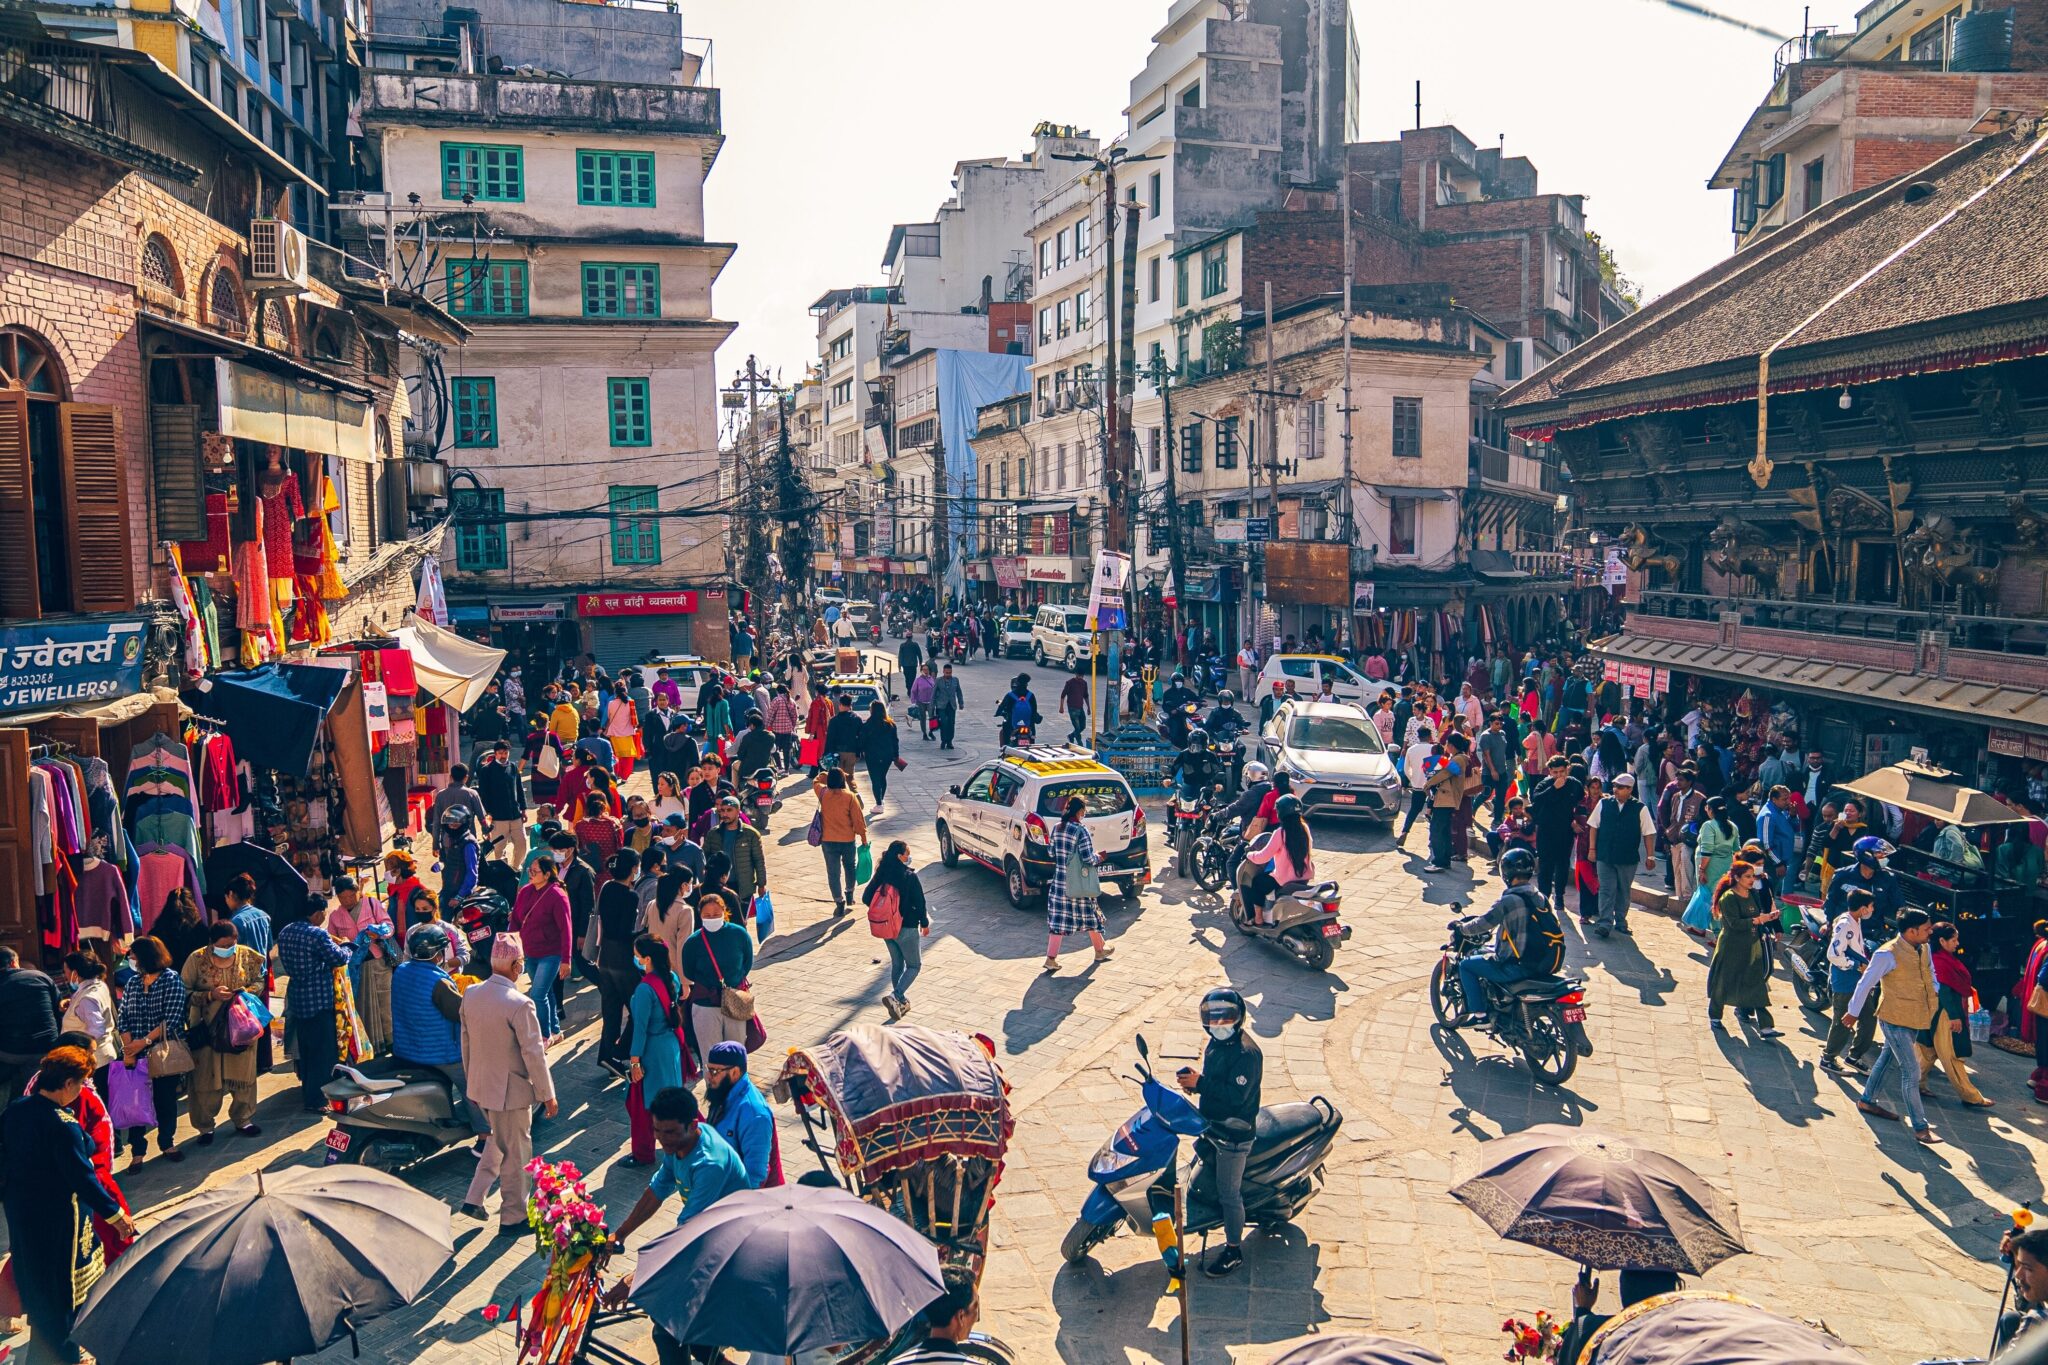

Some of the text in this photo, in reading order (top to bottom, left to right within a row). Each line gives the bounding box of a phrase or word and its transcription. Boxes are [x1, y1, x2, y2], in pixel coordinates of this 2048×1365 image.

[11, 634, 117, 670] ज्वेलर्स
[3, 680, 108, 706] JEWELLERS
[1058, 786, 1113, 797] SPORTS
